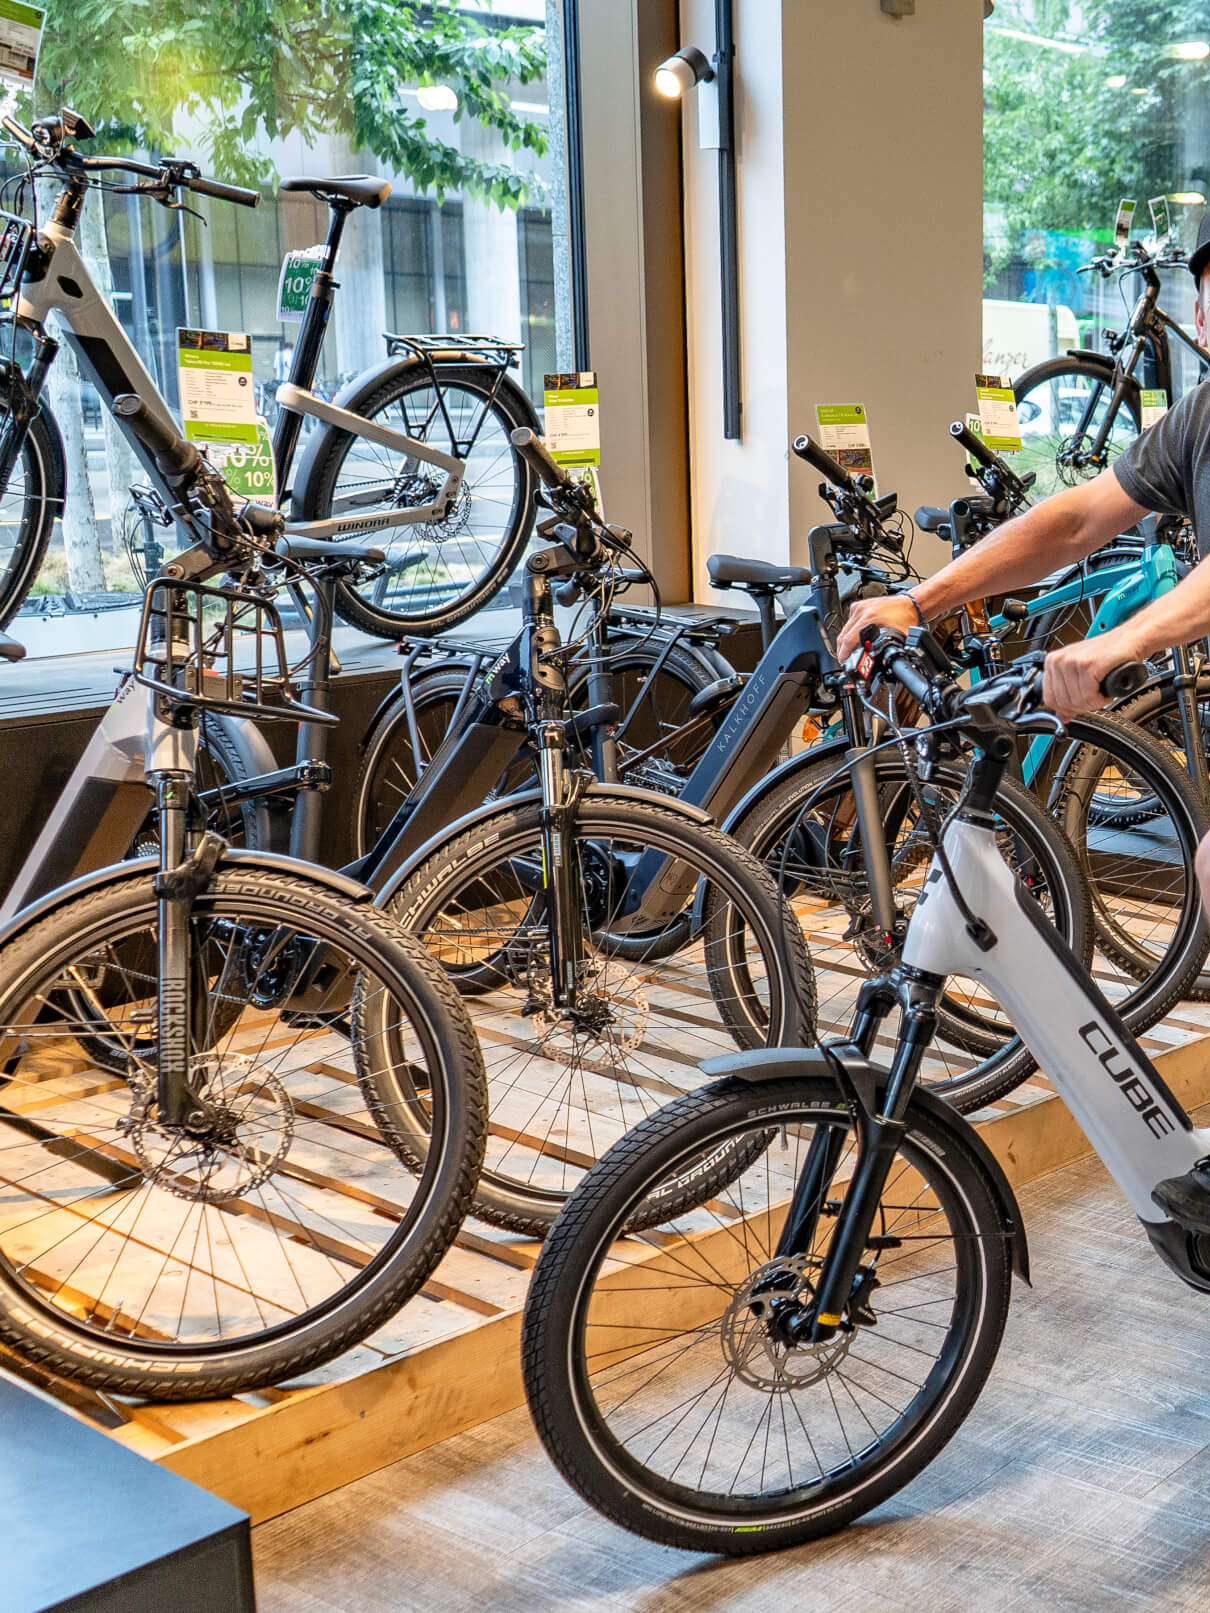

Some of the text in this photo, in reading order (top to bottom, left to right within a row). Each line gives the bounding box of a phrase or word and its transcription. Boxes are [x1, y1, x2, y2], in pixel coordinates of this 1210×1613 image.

[337, 517, 391, 532] WINORA
[485, 652, 511, 685] mway
[716, 673, 767, 752] KALKHOFF
[399, 831, 500, 929] CHWALBE
[161, 978, 186, 1073] ROCKSHOX
[747, 1101, 831, 1118] SCHWALBE
[1078, 1020, 1176, 1140] CUBE
